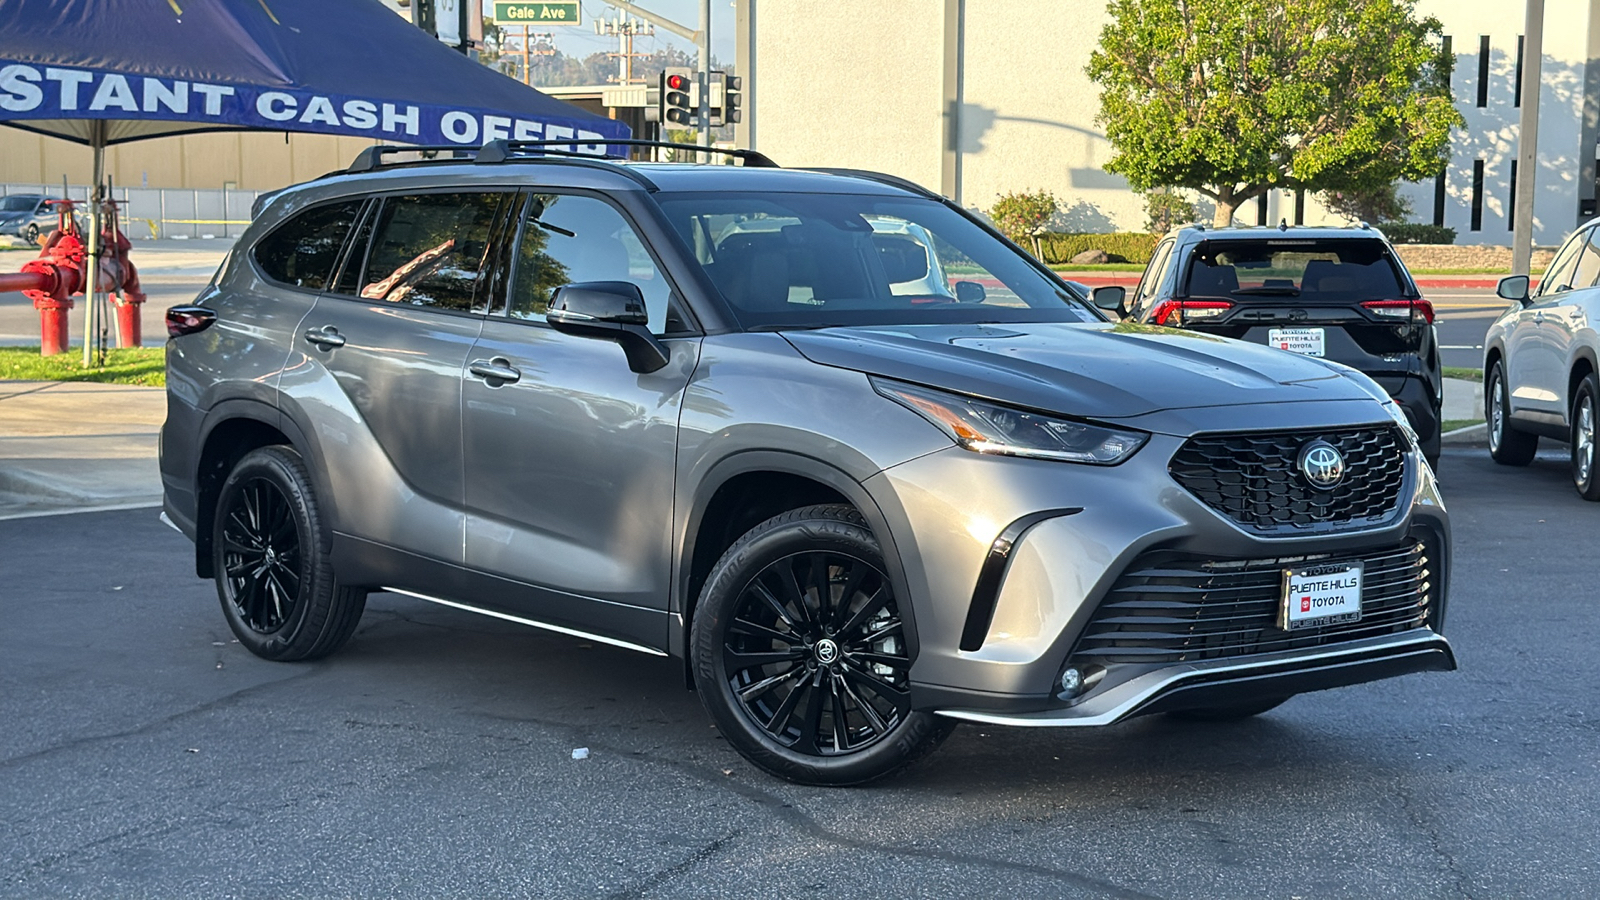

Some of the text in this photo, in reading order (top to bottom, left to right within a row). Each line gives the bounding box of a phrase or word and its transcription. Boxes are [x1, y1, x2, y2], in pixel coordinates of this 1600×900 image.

[507, 6, 566, 19] Gale Ave
[256, 91, 420, 136] CASH
[1308, 565, 1346, 576] TOYOTA
[1290, 578, 1357, 594] PUENTE HILLS
[1312, 596, 1344, 608] TOYOTA
[1292, 612, 1357, 628] PUENTE HILLS
